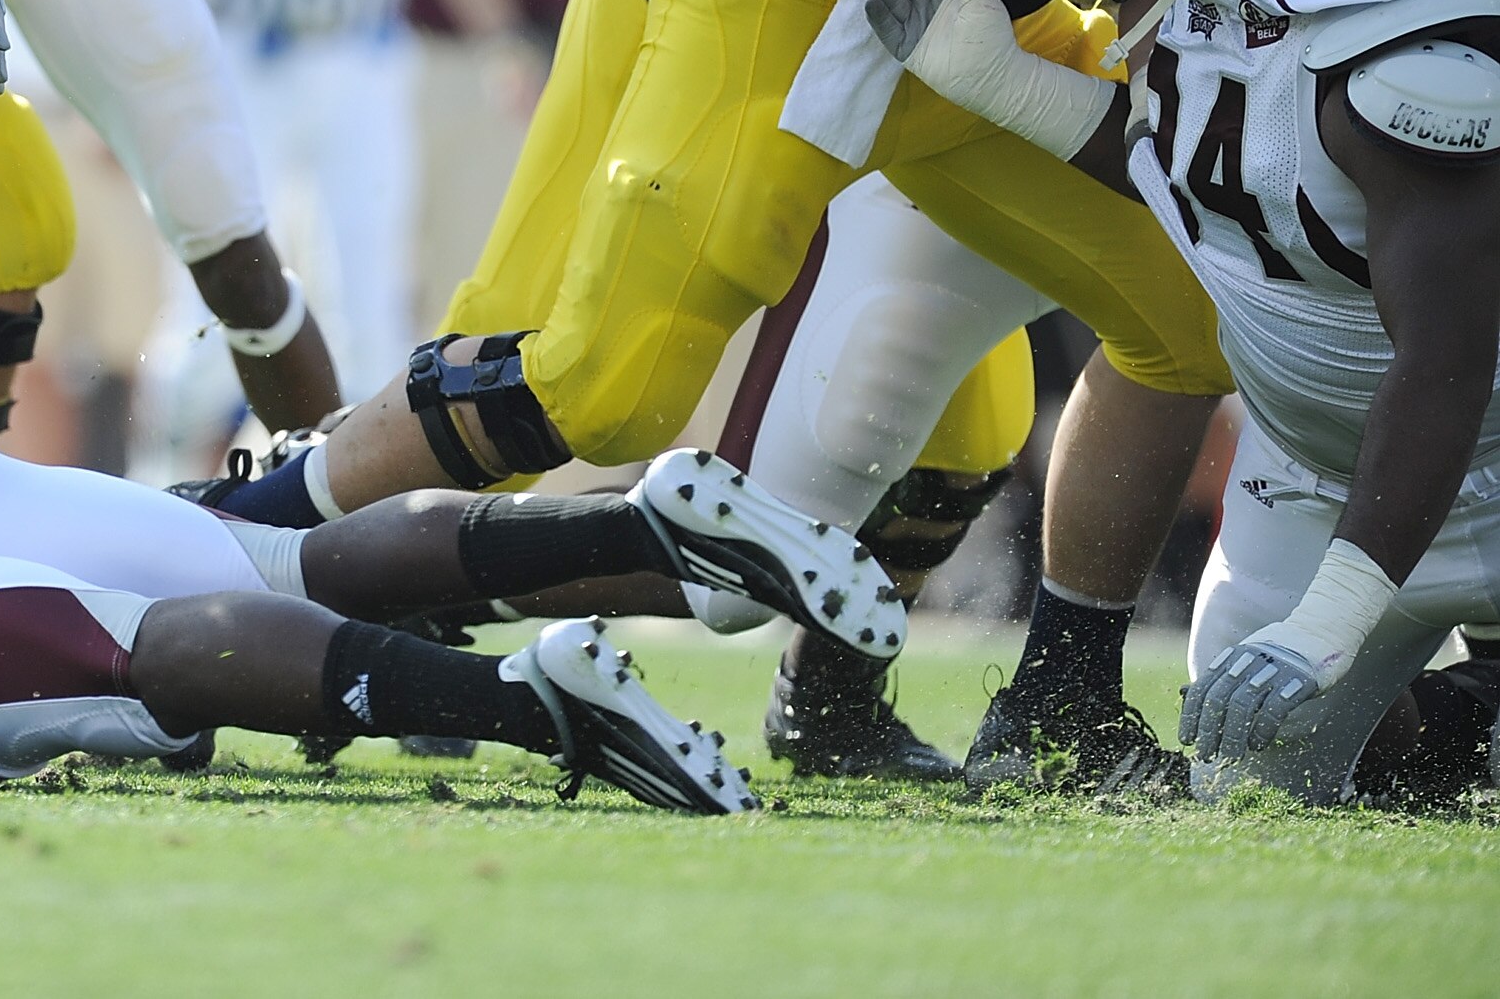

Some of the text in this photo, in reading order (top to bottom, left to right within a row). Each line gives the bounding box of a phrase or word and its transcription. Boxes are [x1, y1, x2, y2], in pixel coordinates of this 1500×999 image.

[1257, 29, 1278, 40] BELL
[1388, 102, 1492, 149] DOUGLAS
[1239, 479, 1274, 509] adidas
